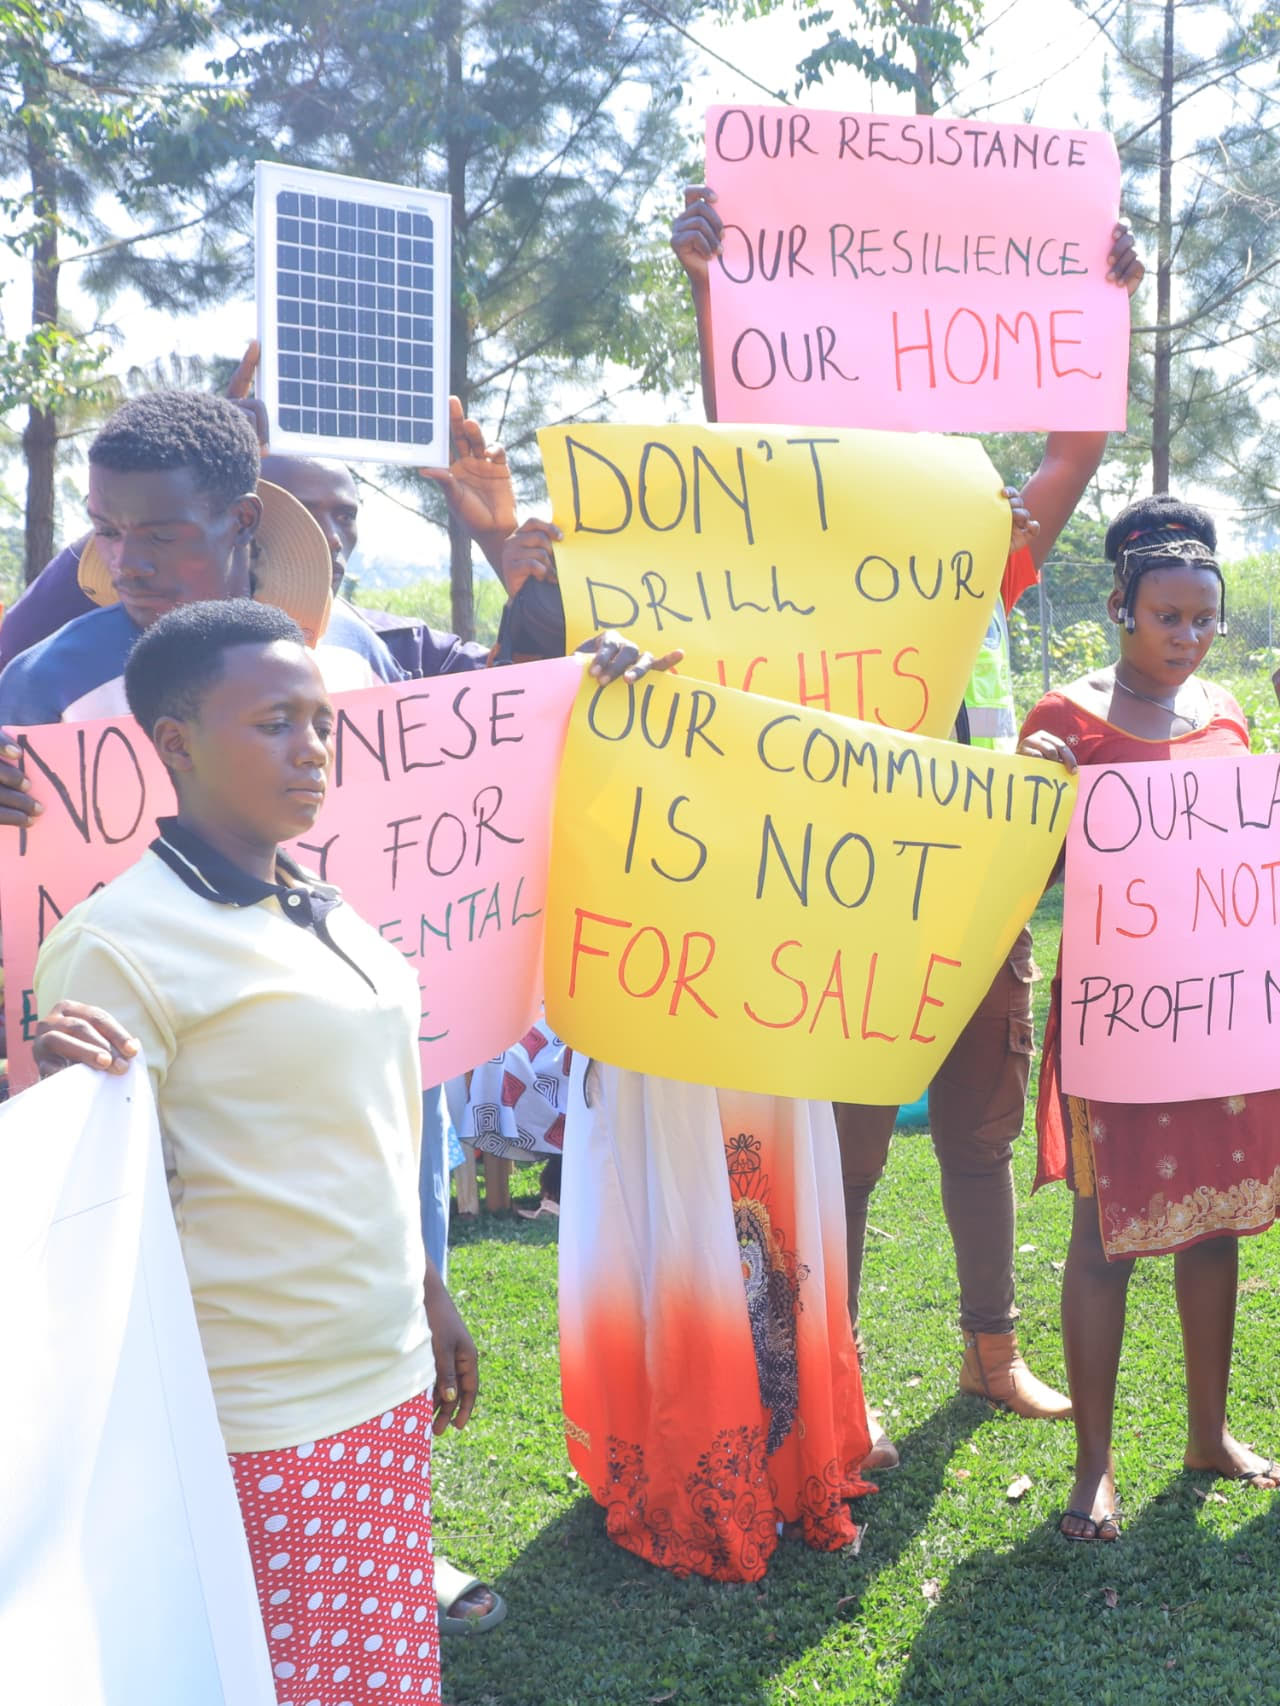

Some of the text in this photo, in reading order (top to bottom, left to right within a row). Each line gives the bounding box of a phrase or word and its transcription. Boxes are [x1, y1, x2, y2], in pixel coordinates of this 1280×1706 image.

[715, 110, 1088, 169] OUR RESISTANCE
[717, 224, 1088, 284] OUR RESILIENCE
[731, 307, 1102, 391] OUR HOME
[565, 435, 840, 545] DON'T
[586, 550, 985, 631] DRILL OUR
[17, 682, 526, 857] NO NESE
[588, 682, 1069, 833] OUR COMMUNITY
[383, 786, 525, 890] FOR
[624, 787, 708, 882] IS
[1083, 770, 1228, 853] OUR
[1095, 878, 1158, 946] IS
[568, 908, 718, 1019] FOR
[744, 940, 963, 1044] SALE
[1071, 970, 1245, 1046] PROFIT
